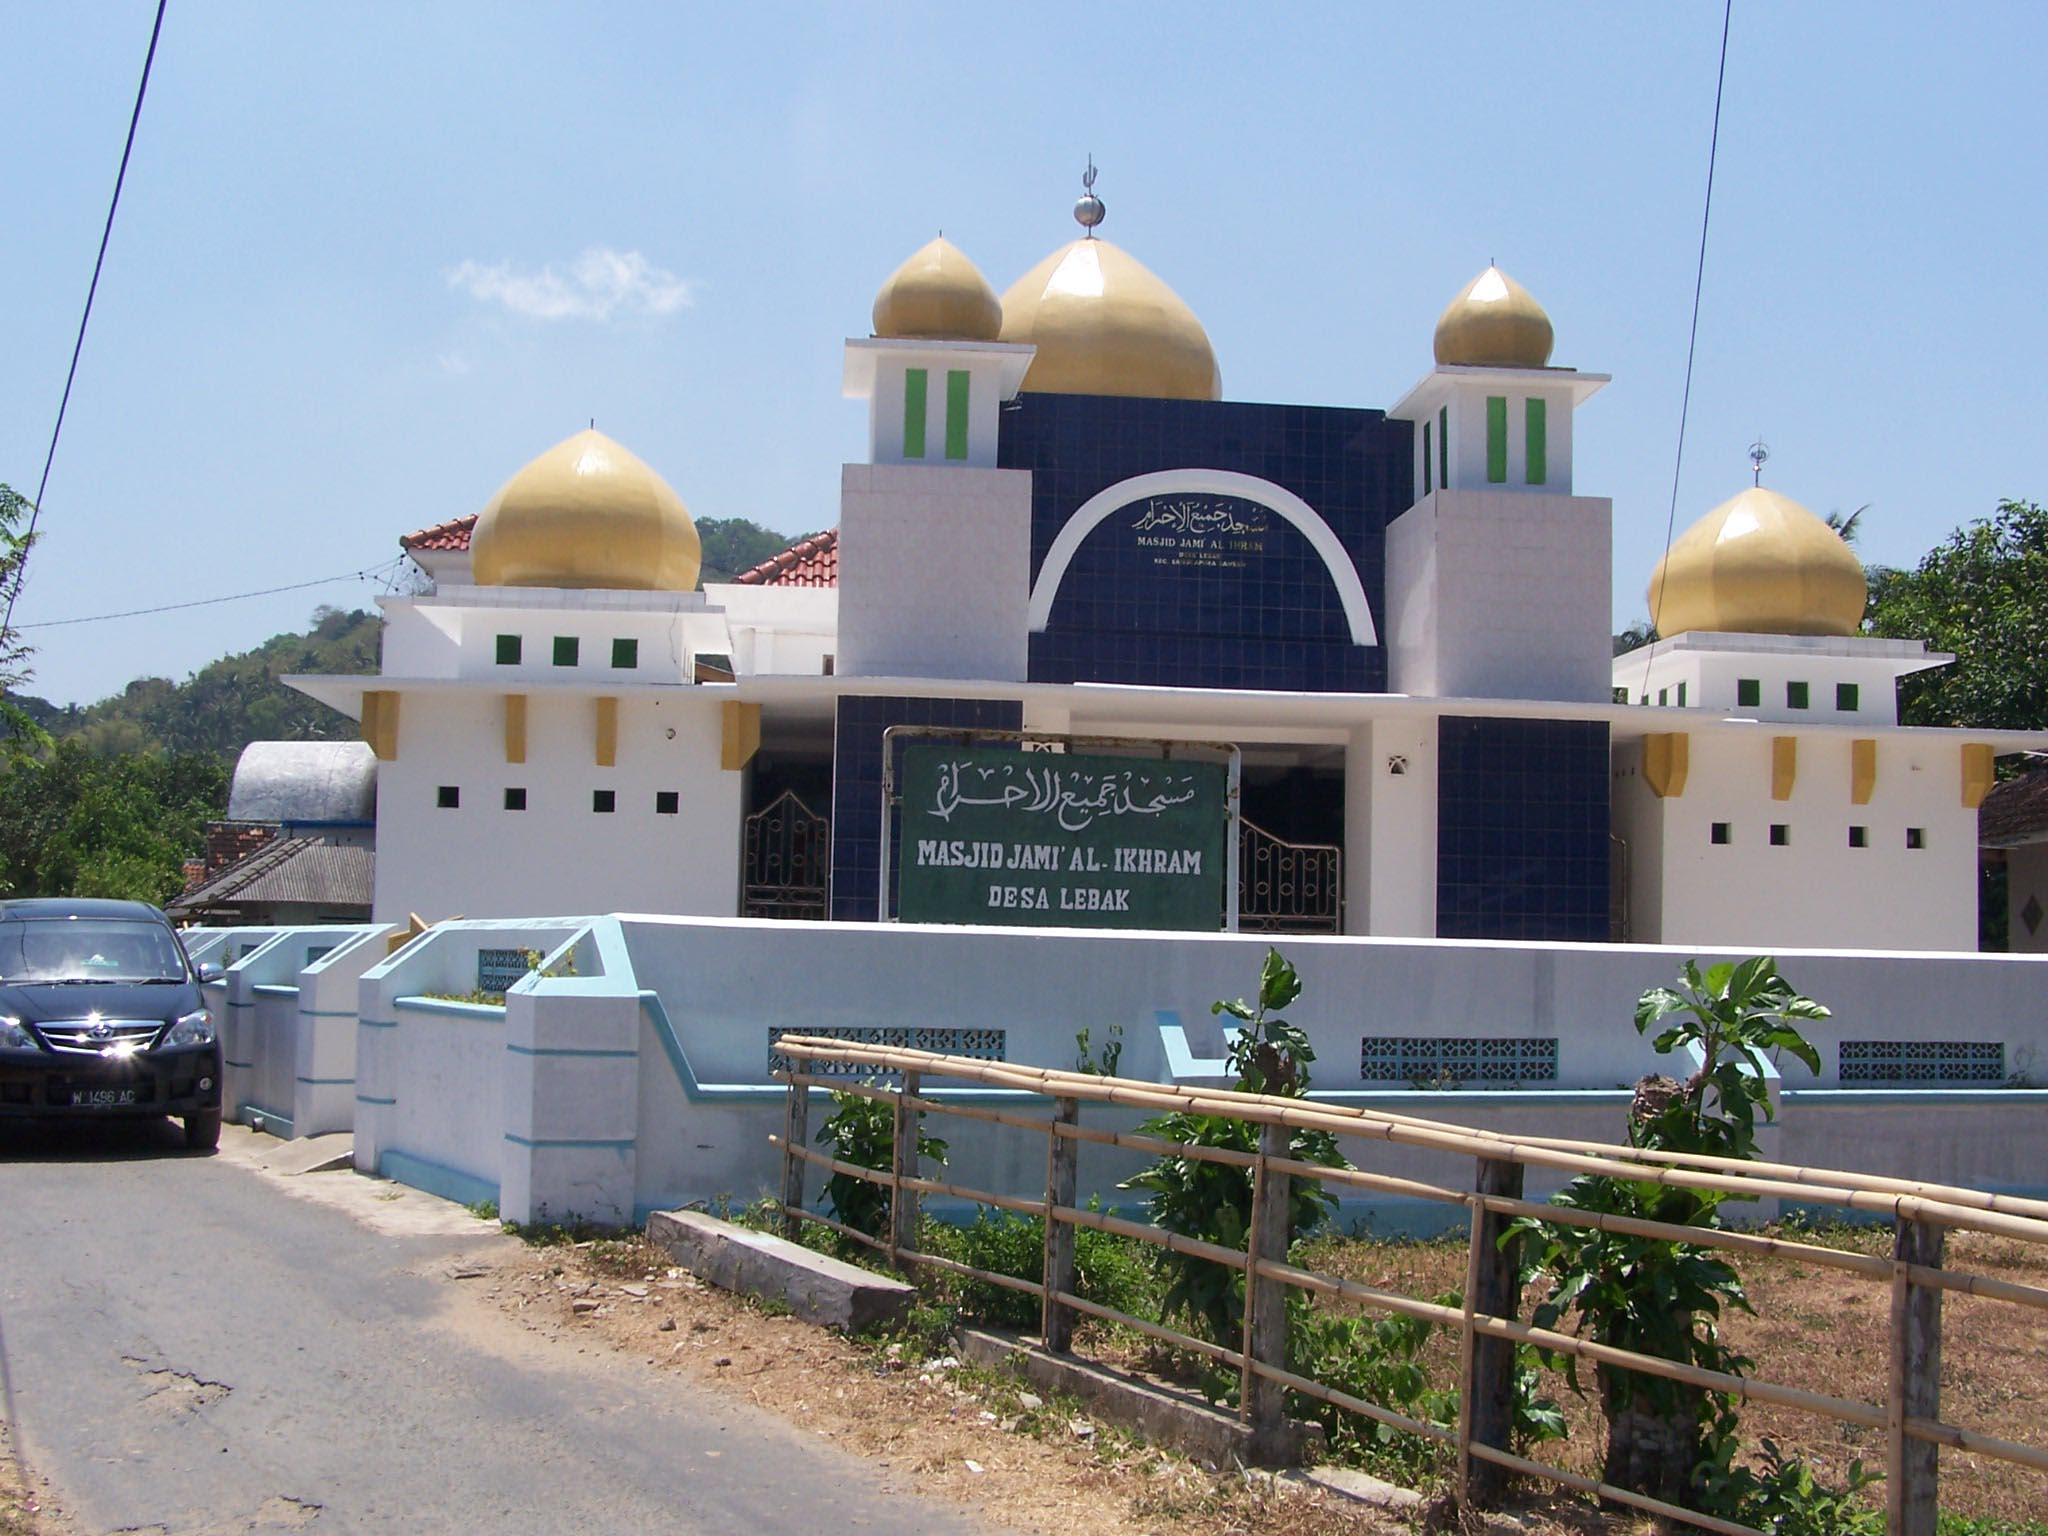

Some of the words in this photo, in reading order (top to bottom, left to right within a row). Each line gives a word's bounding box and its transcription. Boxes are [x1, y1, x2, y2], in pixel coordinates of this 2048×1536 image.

[1137, 536, 1175, 547] MASJID
[1211, 540, 1224, 550] AL
[917, 839, 1003, 868] MASJID
[1114, 847, 1202, 875] IKHRAM
[988, 885, 1049, 910] DESA
[1060, 887, 1131, 911] LEBAK
[120, 1089, 135, 1103] AC
